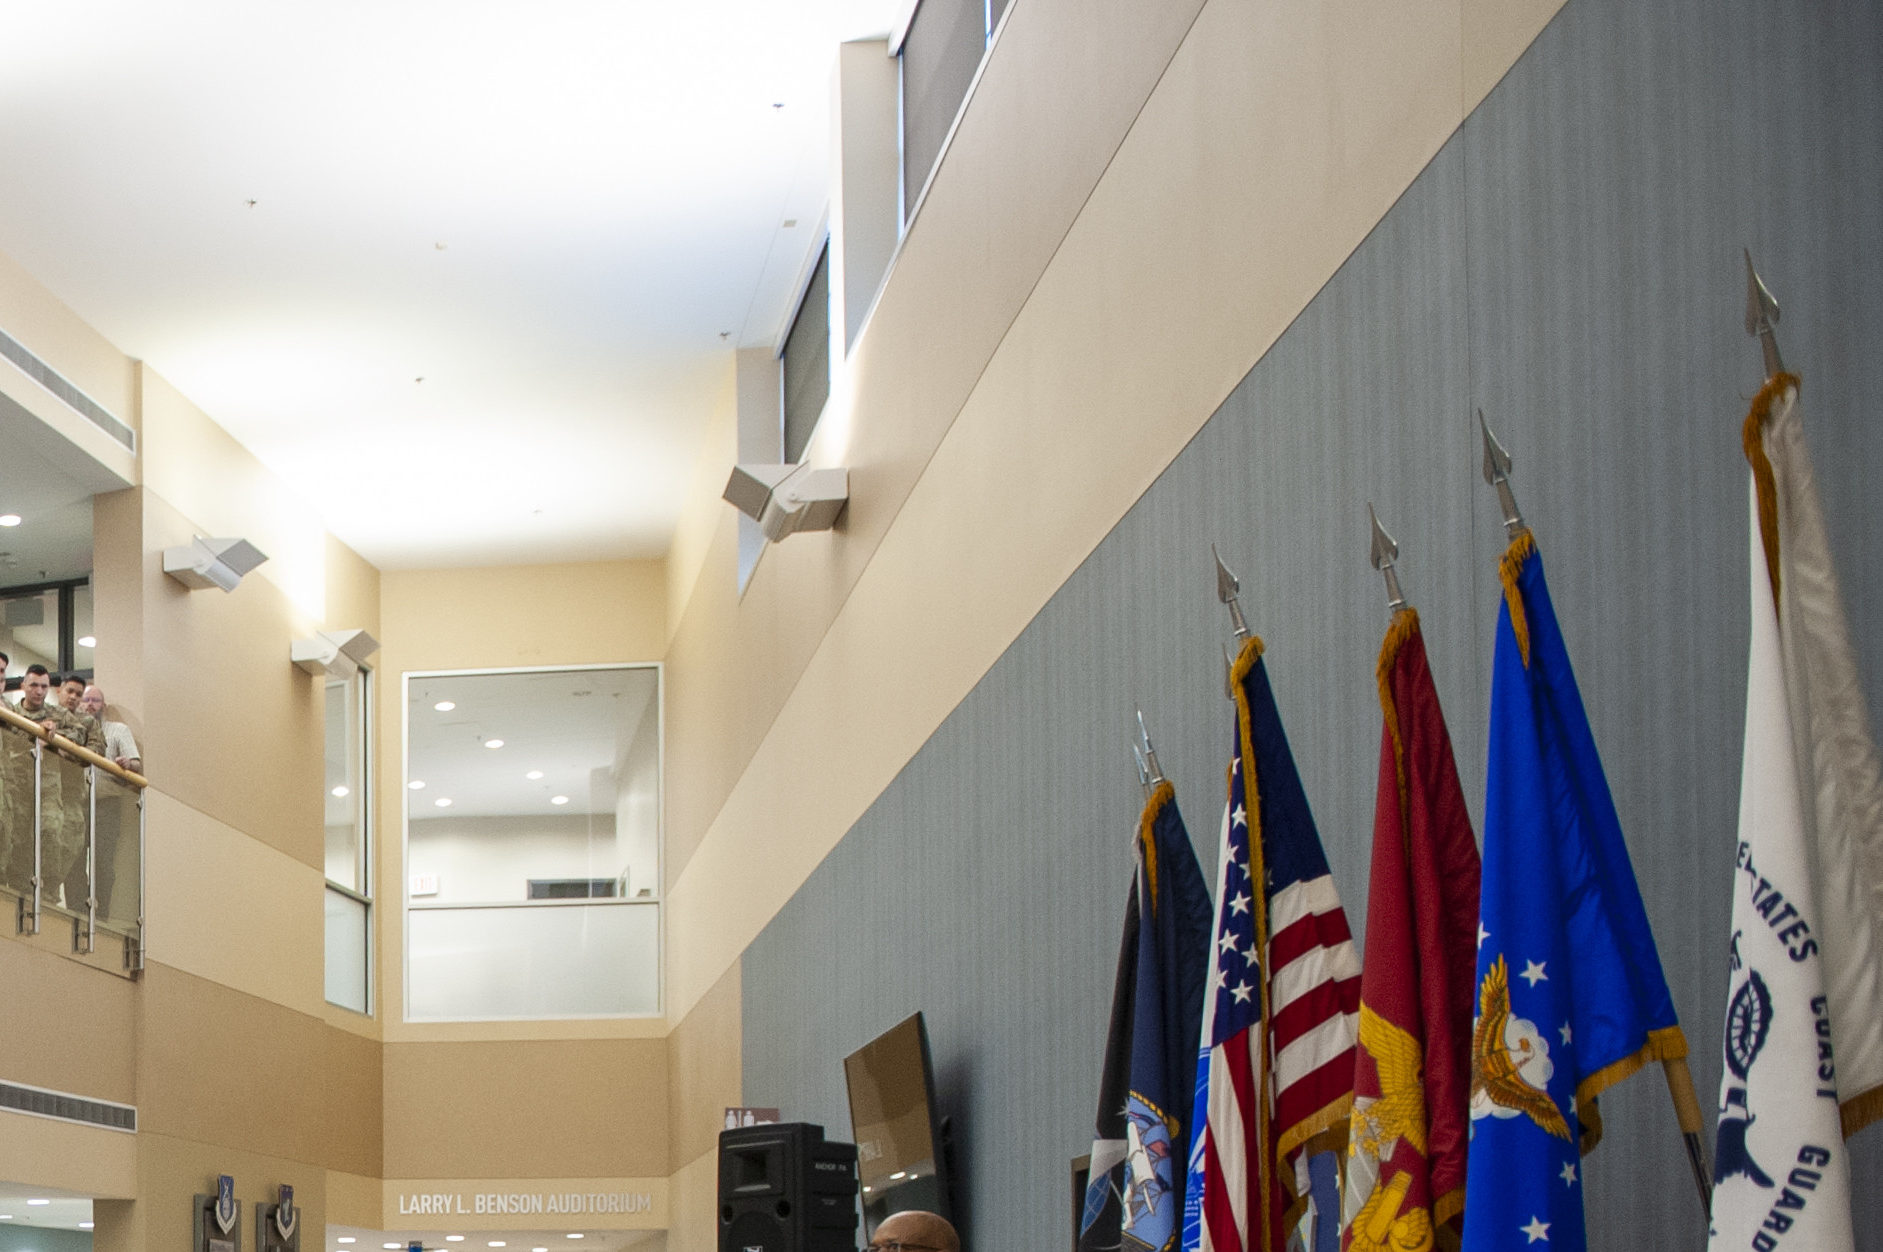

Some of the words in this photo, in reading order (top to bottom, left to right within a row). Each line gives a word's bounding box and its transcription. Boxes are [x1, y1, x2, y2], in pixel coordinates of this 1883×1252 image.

[1747, 874, 1819, 963] TATES
[399, 1194, 454, 1215] LARRY
[456, 1194, 472, 1215] L.
[475, 1194, 543, 1215] BENSON
[546, 1192, 652, 1214] AUDITORIUM
